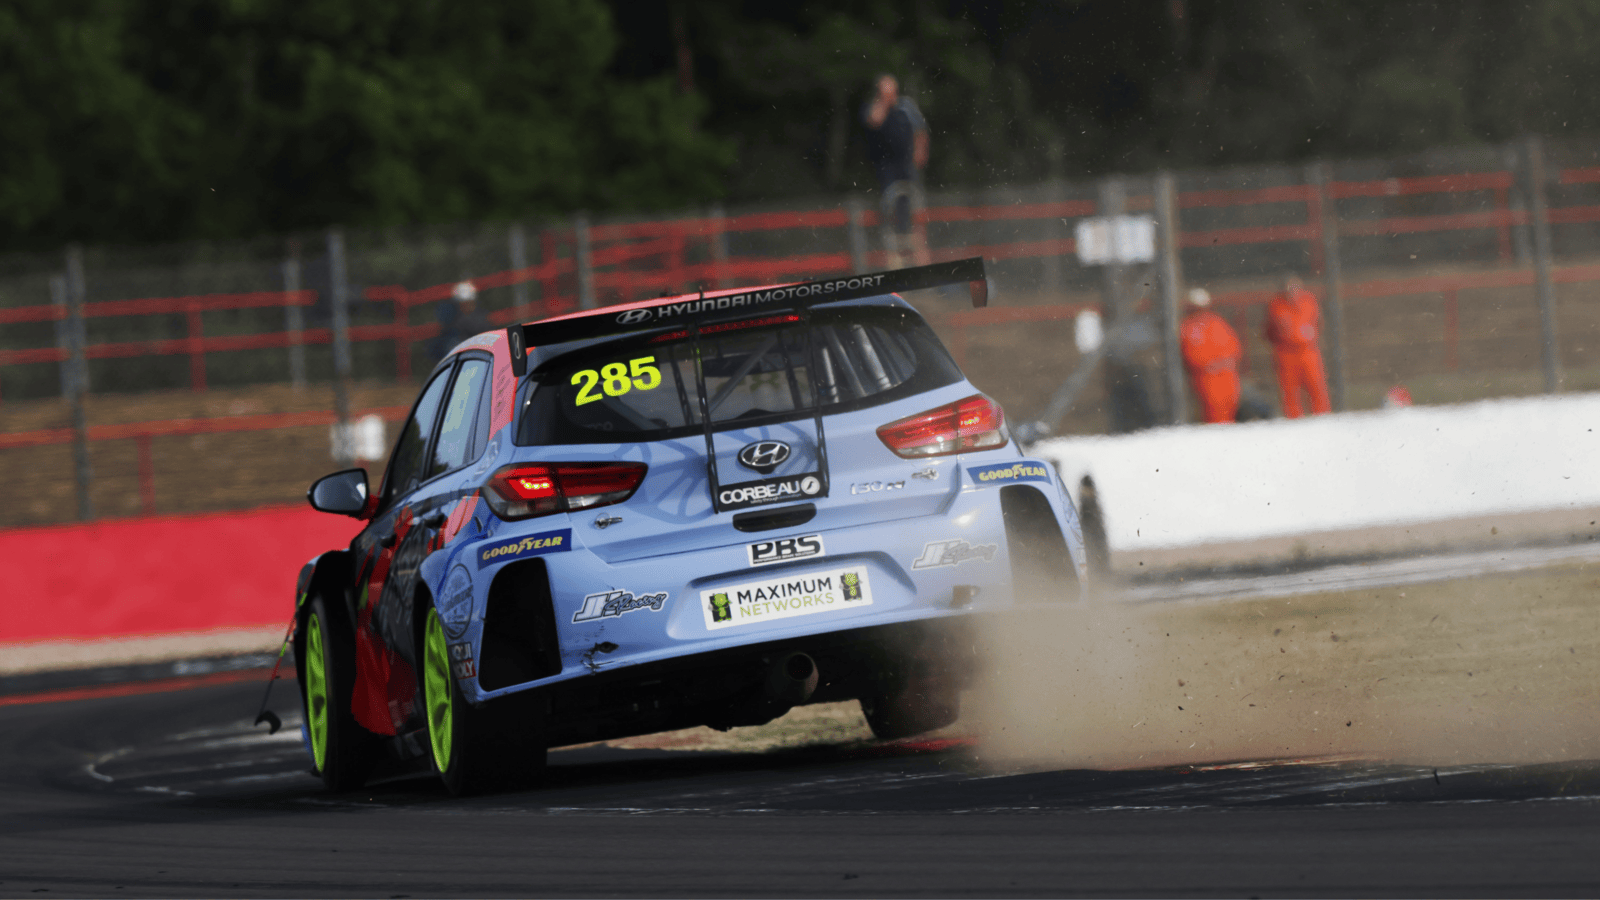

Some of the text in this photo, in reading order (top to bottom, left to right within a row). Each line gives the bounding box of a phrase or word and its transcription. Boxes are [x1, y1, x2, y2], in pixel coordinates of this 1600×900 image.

[658, 275, 885, 317] HYUNDAI MOTORSPORT
[570, 355, 662, 407] 285
[979, 464, 1047, 481] GOODYEAR
[719, 480, 800, 504] CORBEAU
[482, 536, 563, 560] GOODYEAR
[751, 535, 820, 564] PBS
[736, 576, 833, 605] MAXIMUM
[604, 593, 667, 616] Racing
[739, 592, 835, 618] NETWORKS
